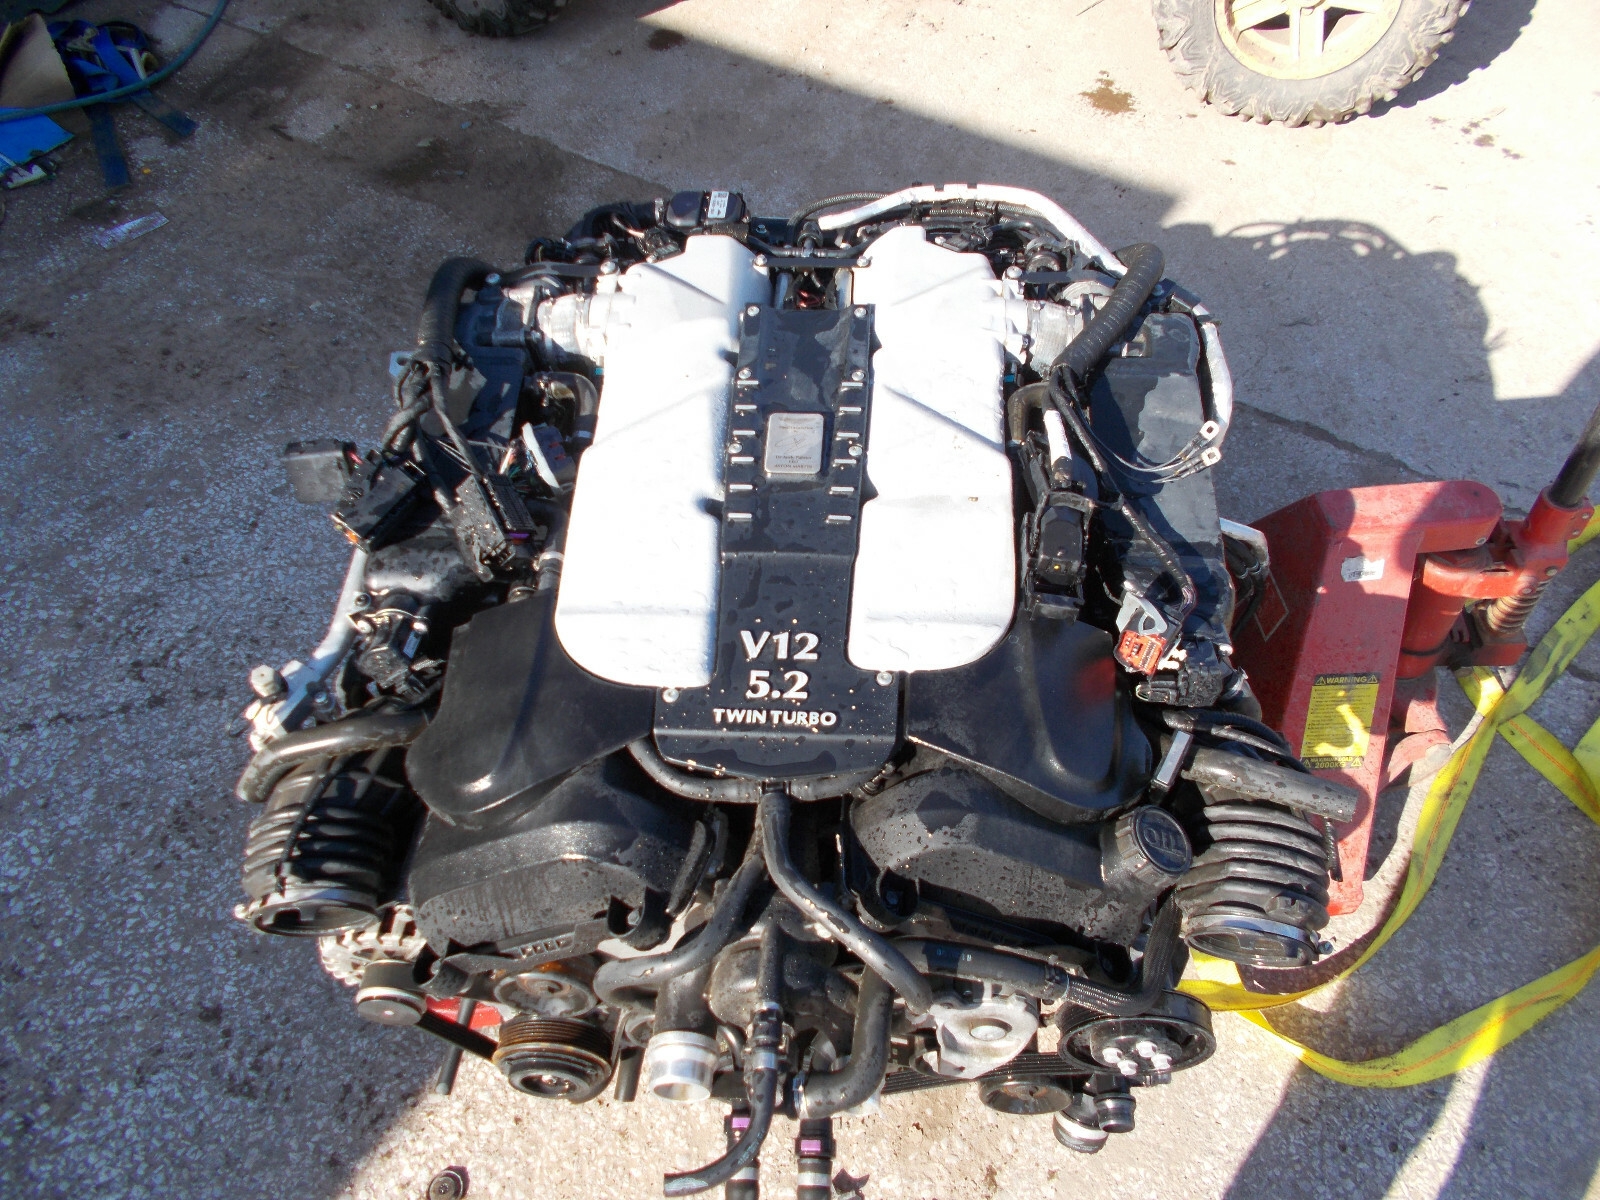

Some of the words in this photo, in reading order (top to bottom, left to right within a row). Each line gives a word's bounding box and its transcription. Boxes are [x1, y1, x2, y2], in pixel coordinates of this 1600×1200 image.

[740, 630, 819, 660] V12
[745, 669, 809, 699] 5.2
[1326, 675, 1367, 684] WARNING
[713, 708, 767, 724] TWIN
[770, 710, 837, 726] TURBO
[1143, 826, 1186, 857] OIL
